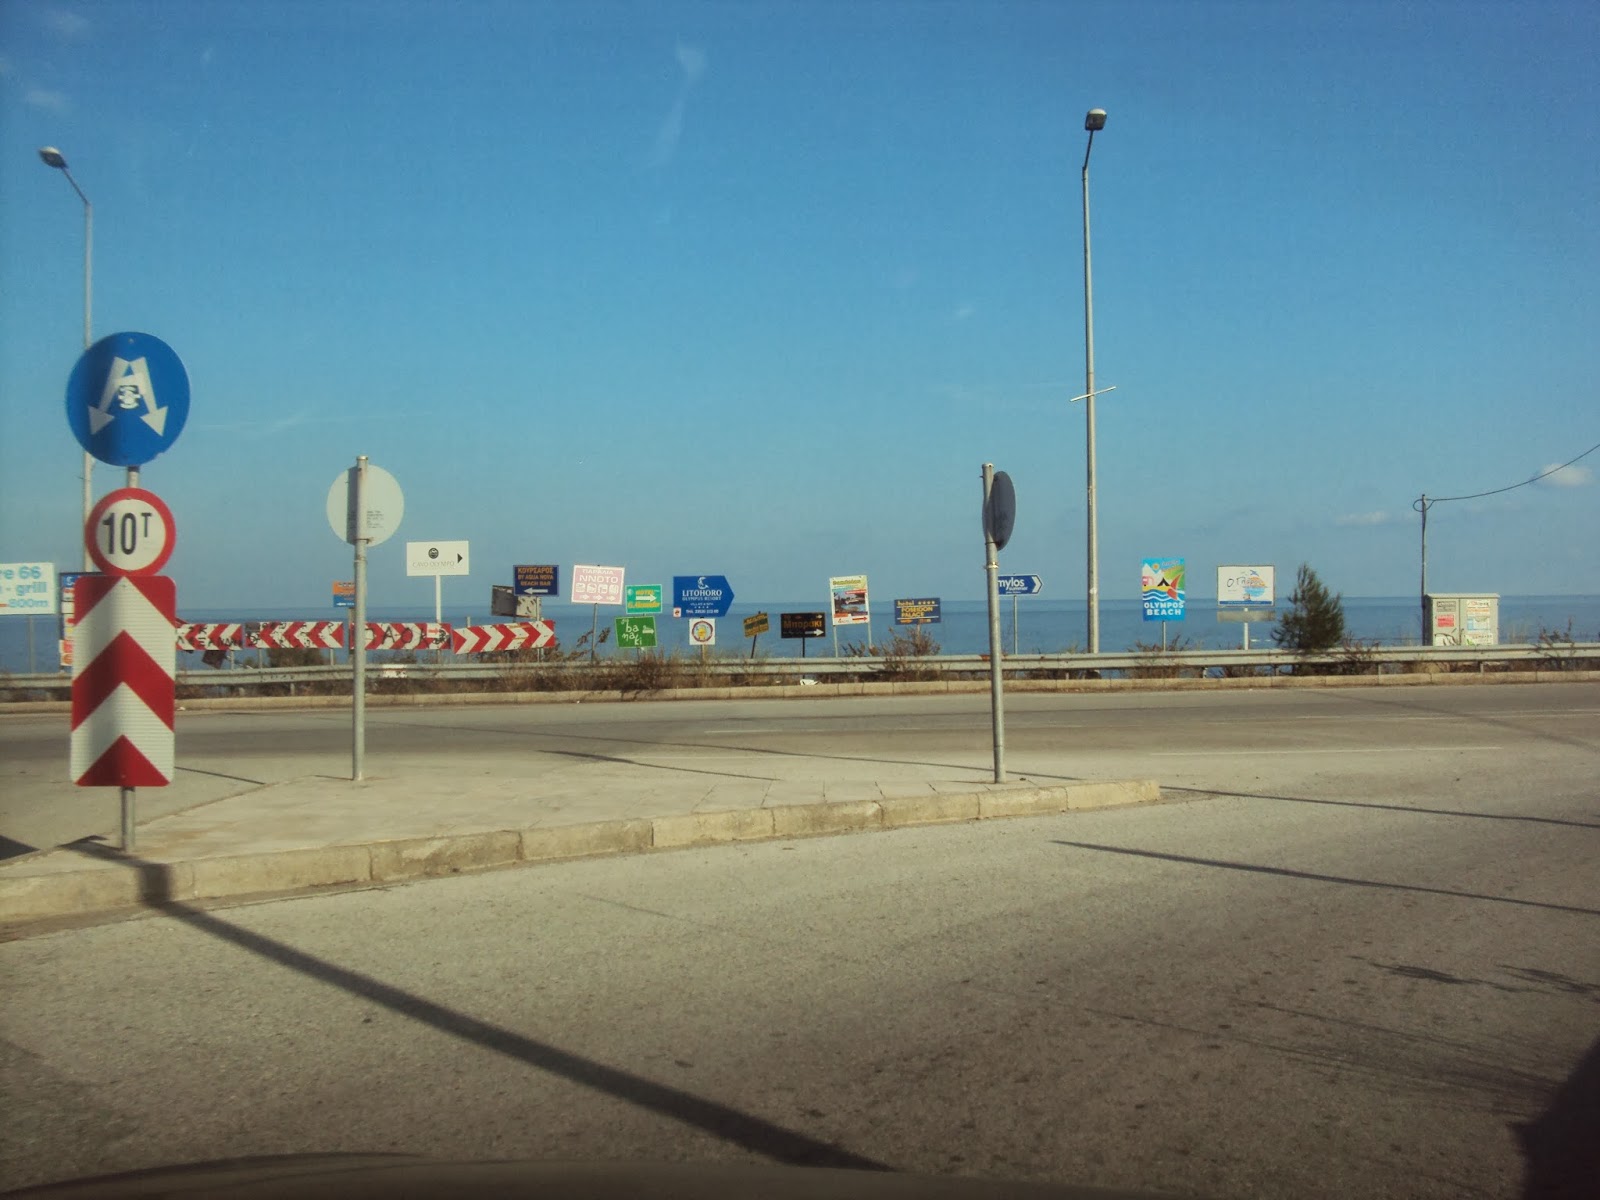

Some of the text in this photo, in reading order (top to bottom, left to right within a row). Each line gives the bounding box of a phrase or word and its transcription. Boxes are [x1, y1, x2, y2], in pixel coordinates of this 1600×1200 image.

[16, 581, 48, 597] grill
[682, 589, 723, 597] LITOHORO
[1146, 608, 1182, 616] BEACH
